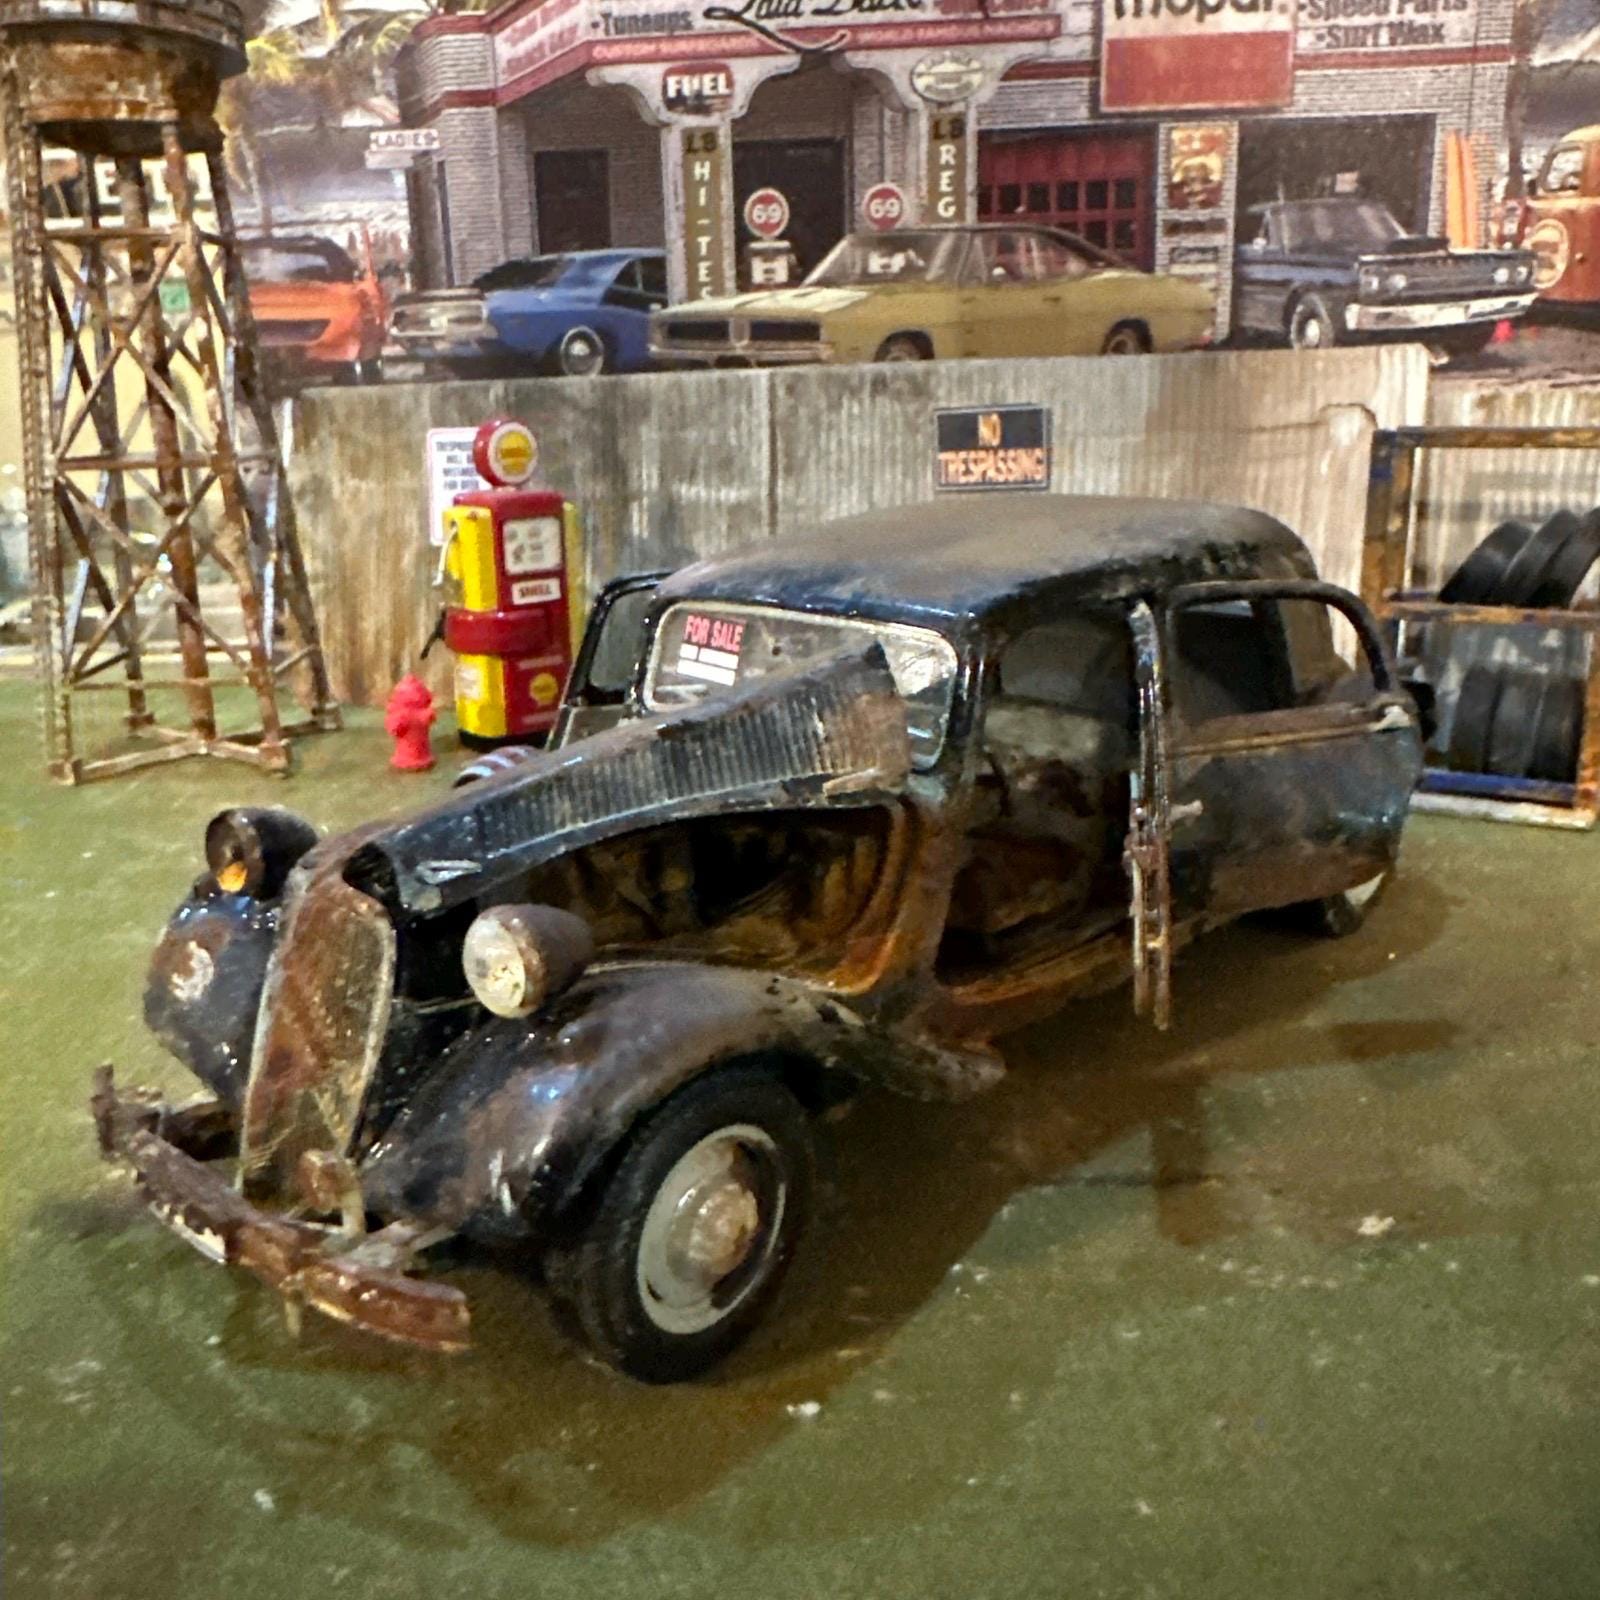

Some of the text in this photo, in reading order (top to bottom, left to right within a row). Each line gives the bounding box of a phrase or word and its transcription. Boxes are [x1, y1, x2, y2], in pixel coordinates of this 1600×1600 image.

[666, 72, 733, 98] FUEL
[752, 202, 783, 224] 69
[938, 449, 1044, 483] TRESPASSING
[684, 615, 743, 652] FOR SALE
